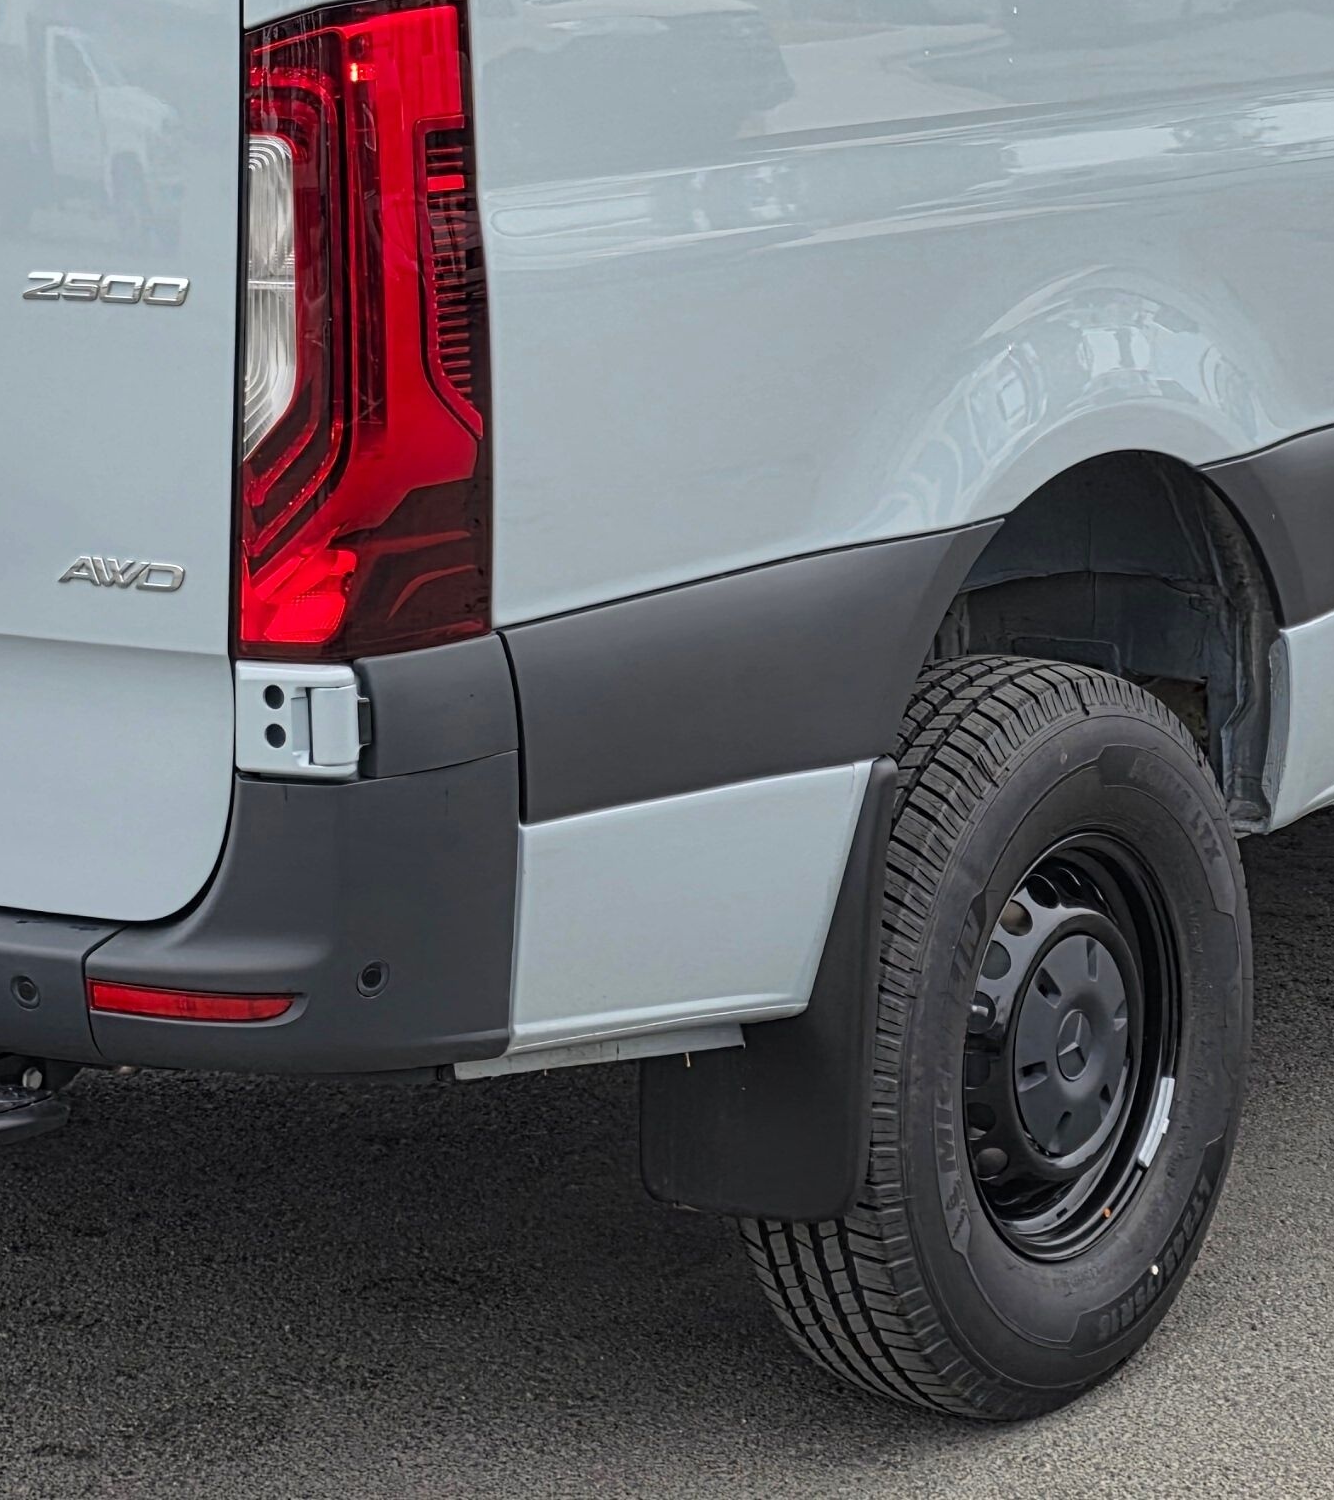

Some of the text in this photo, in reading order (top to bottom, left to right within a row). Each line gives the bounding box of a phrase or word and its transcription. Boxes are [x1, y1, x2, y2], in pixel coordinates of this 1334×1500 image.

[22, 271, 190, 306] 2500
[58, 556, 186, 592] AWD
[933, 905, 982, 1173] MICIN
